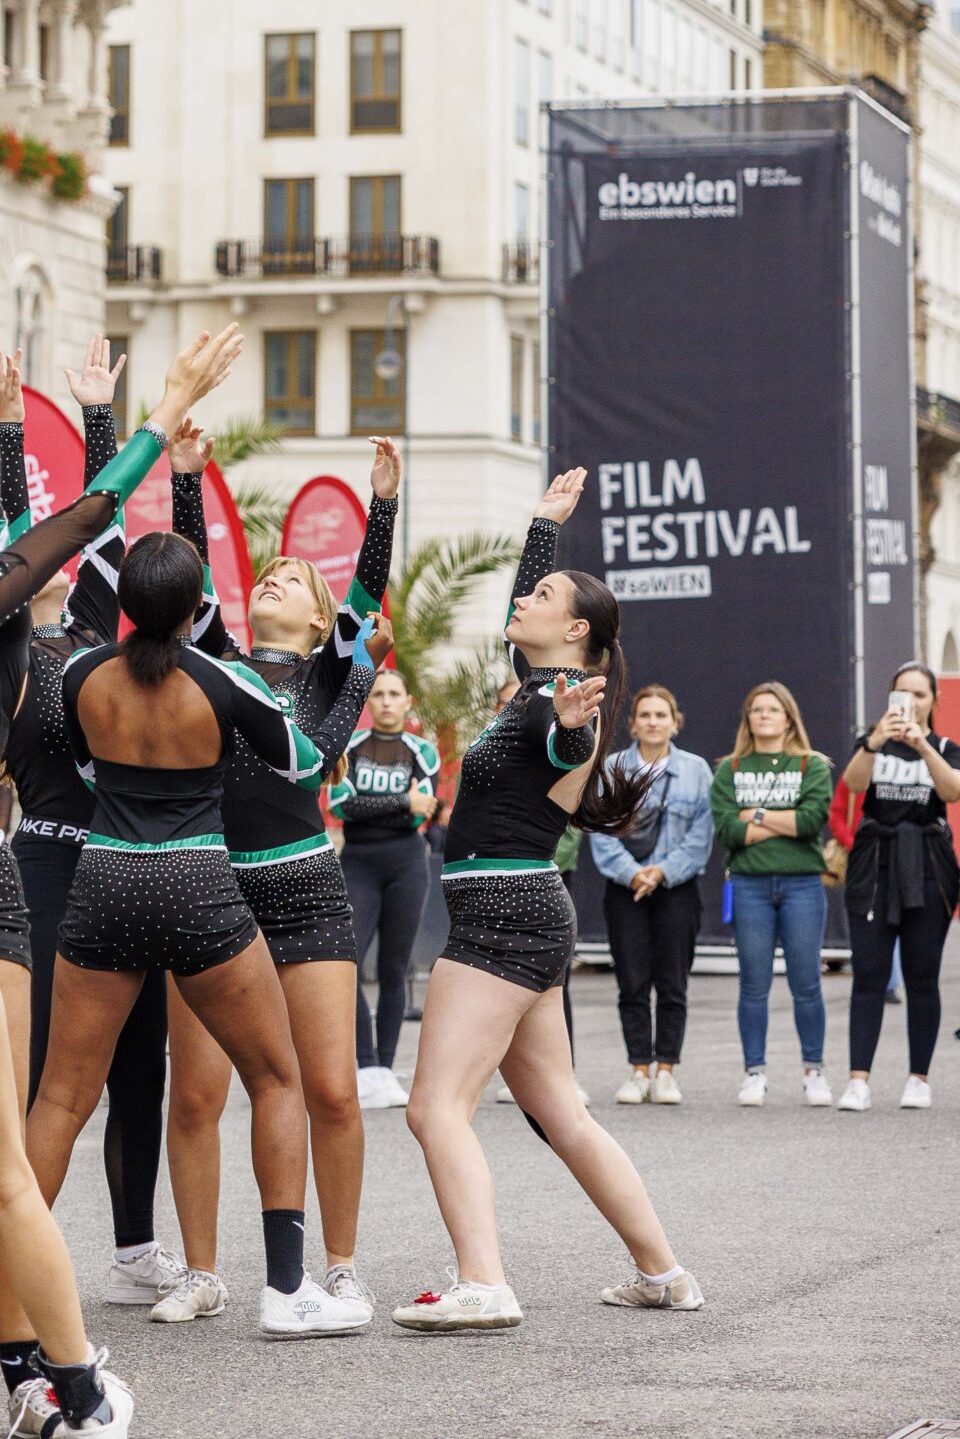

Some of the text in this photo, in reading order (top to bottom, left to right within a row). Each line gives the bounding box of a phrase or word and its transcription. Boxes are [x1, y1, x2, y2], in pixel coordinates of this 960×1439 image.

[598, 172, 737, 206] ebswien
[598, 458, 706, 511] FILM
[601, 506, 812, 564] FESTIVAL
[613, 572, 705, 595] #soWIEN
[355, 767, 407, 794] DDC
[18, 818, 91, 842] NKE PR
